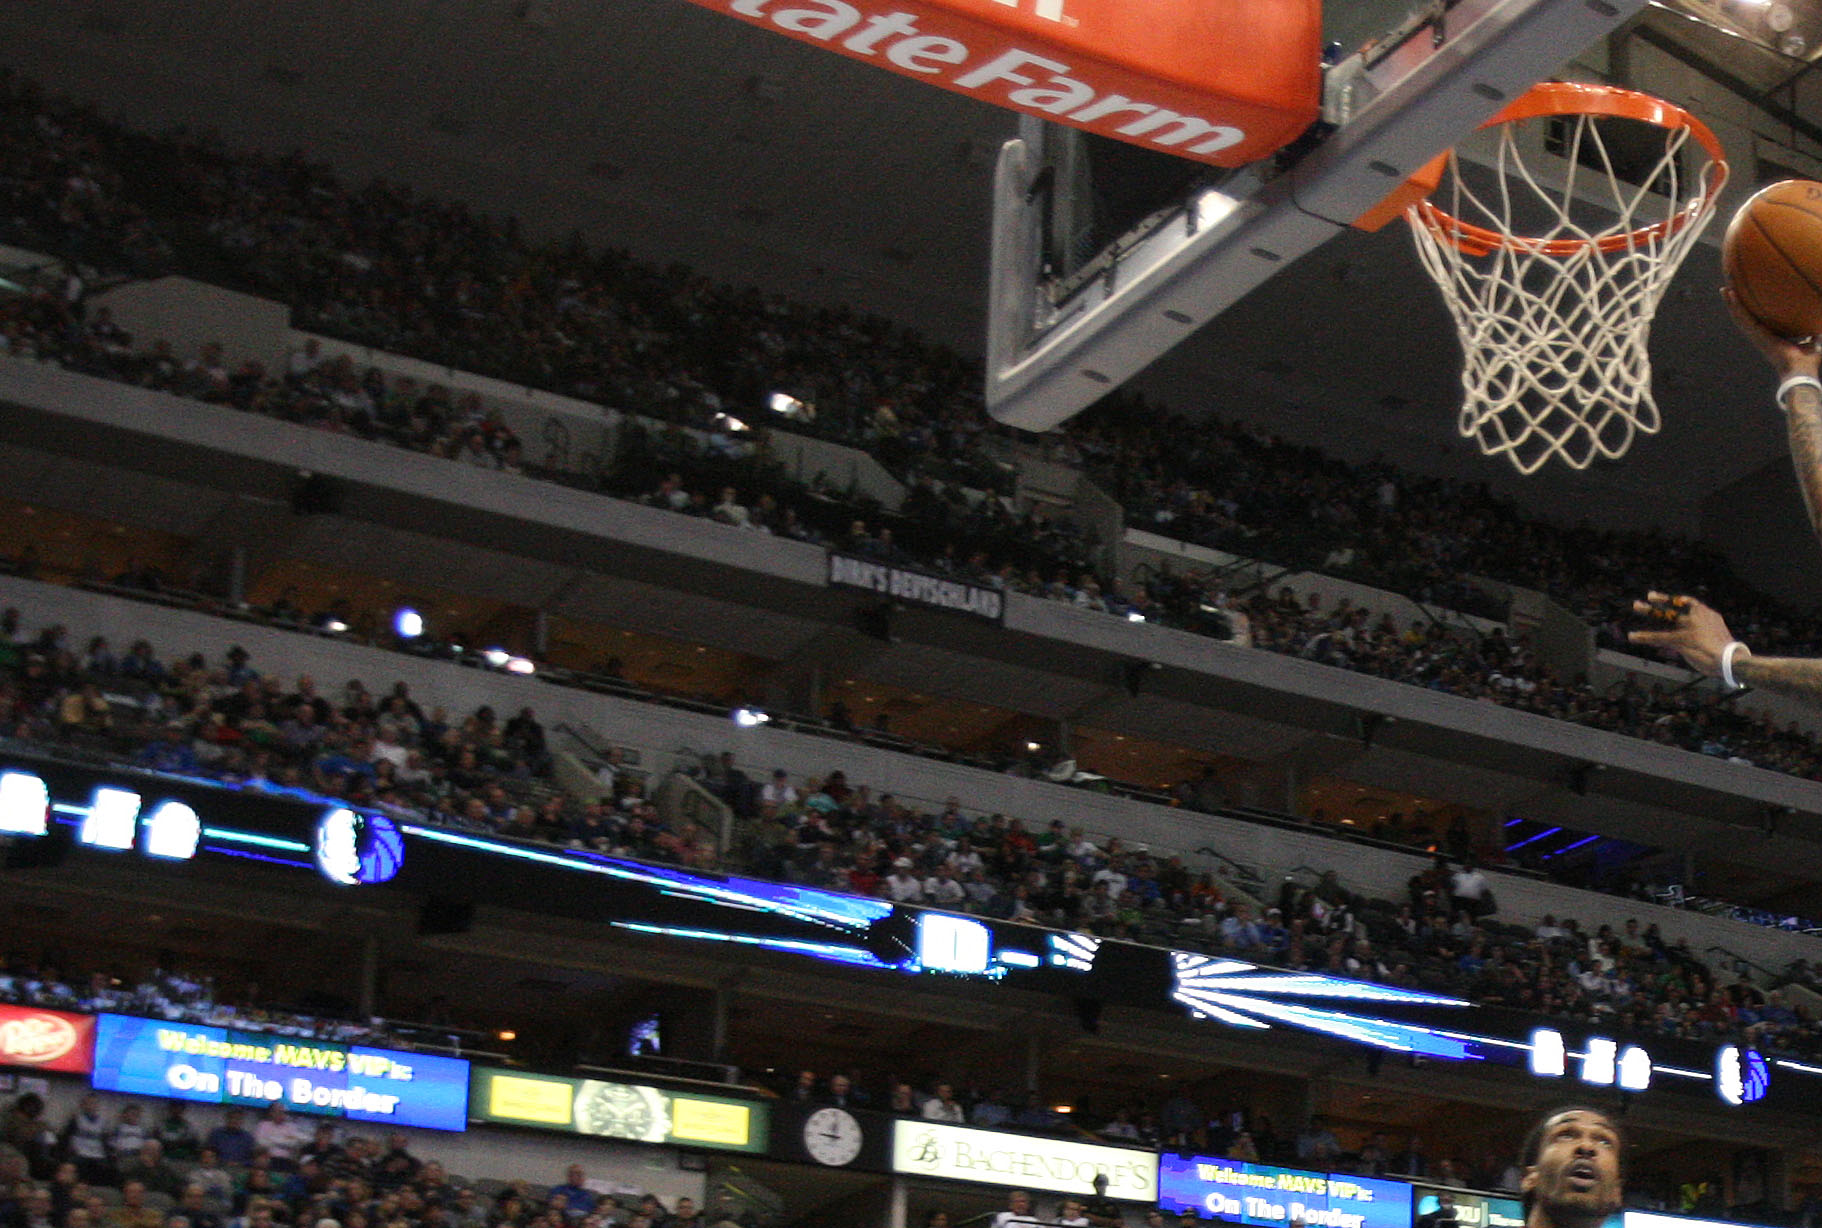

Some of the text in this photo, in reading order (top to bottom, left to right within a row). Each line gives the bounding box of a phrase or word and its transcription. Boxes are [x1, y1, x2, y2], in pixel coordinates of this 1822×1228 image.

[954, 47, 1244, 154] Farm
[158, 1028, 272, 1062] Welcome
[274, 1044, 345, 1072] MAVS
[167, 1063, 400, 1114] On The Border
[1205, 1191, 1241, 1215] On
[1245, 1196, 1285, 1220] The
[1277, 1173, 1327, 1196] MAVS
